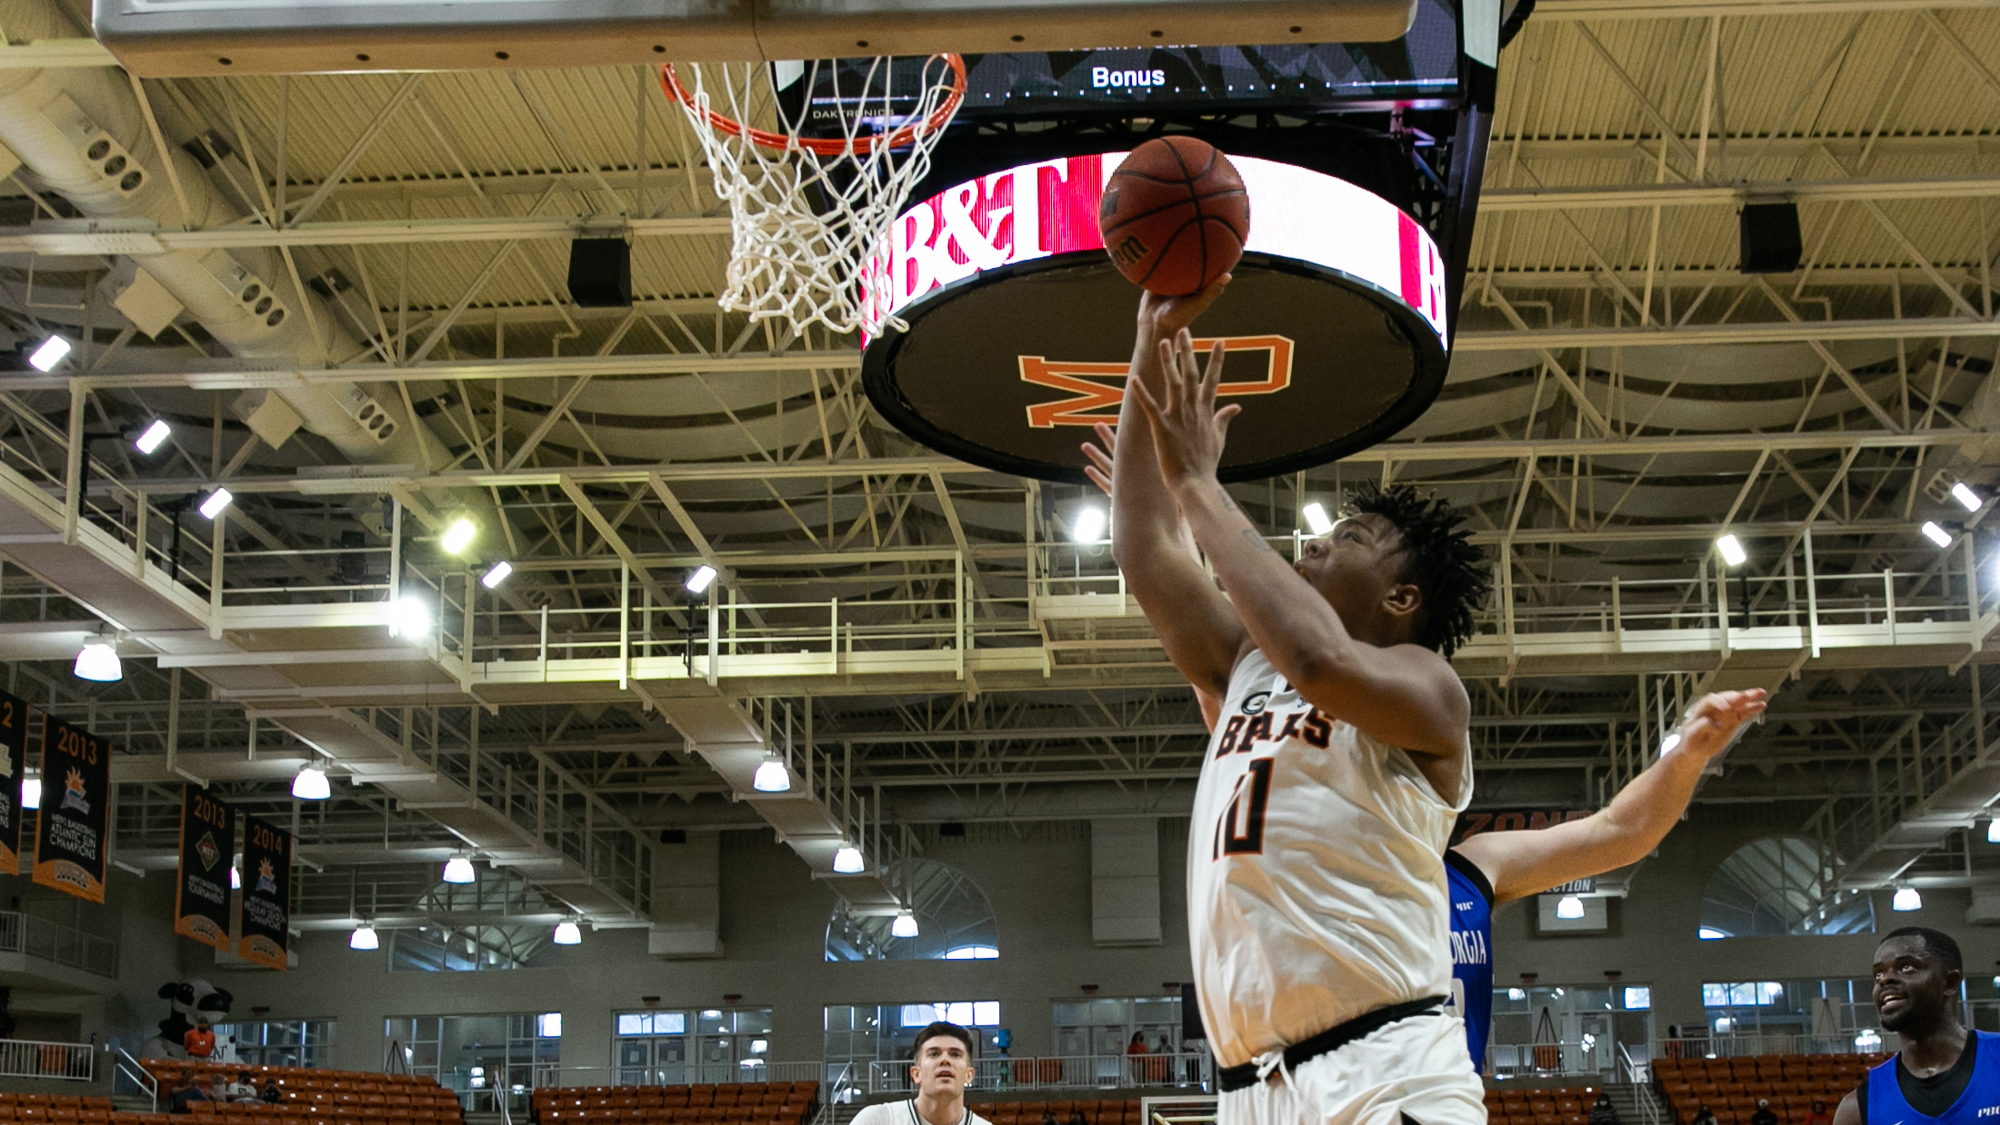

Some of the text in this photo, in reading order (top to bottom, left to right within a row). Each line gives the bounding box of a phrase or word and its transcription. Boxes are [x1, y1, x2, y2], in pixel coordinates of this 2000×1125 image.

[1092, 66, 1165, 88] Bonus
[813, 108, 895, 119] DAKRNICS
[57, 726, 97, 766] 2013
[194, 795, 226, 830] 2013
[49, 833, 96, 861] CHAMPIONS
[50, 823, 97, 849] ATLANTIC SUN
[252, 824, 283, 856] 2014
[202, 845, 216, 859] NIT
[188, 881, 225, 905] TOURNAMENT
[1545, 879, 1592, 893] TION
[1449, 930, 1487, 964] ORGIA
